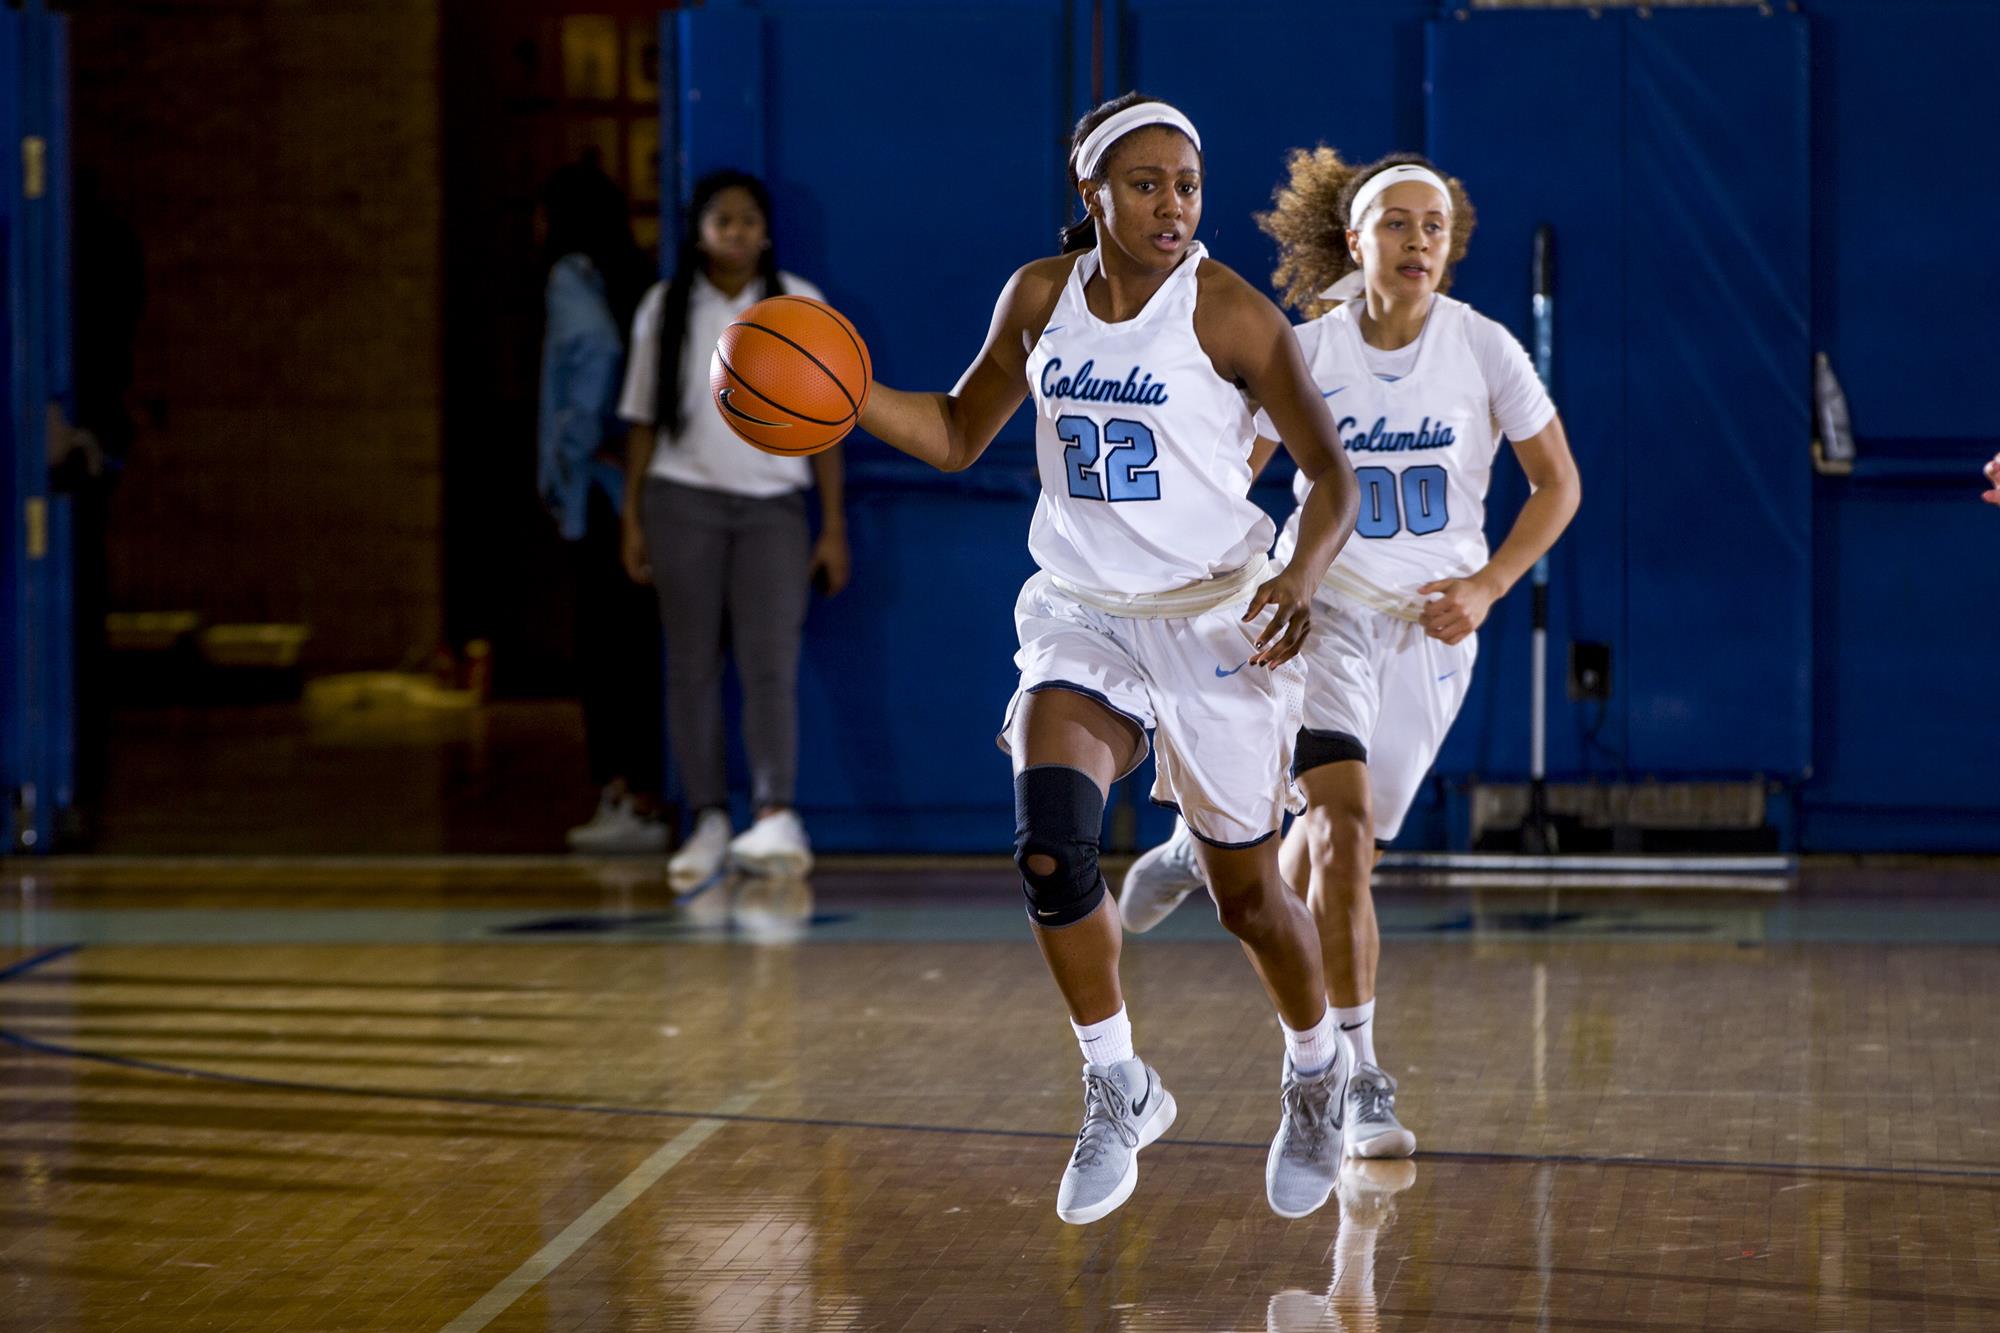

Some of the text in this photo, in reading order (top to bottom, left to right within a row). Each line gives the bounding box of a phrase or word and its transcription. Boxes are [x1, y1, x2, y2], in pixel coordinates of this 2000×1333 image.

[1041, 357, 1169, 406] Columbia
[1056, 415, 1161, 502] 22
[1337, 416, 1456, 452] Columbia
[1354, 464, 1450, 539] 00
